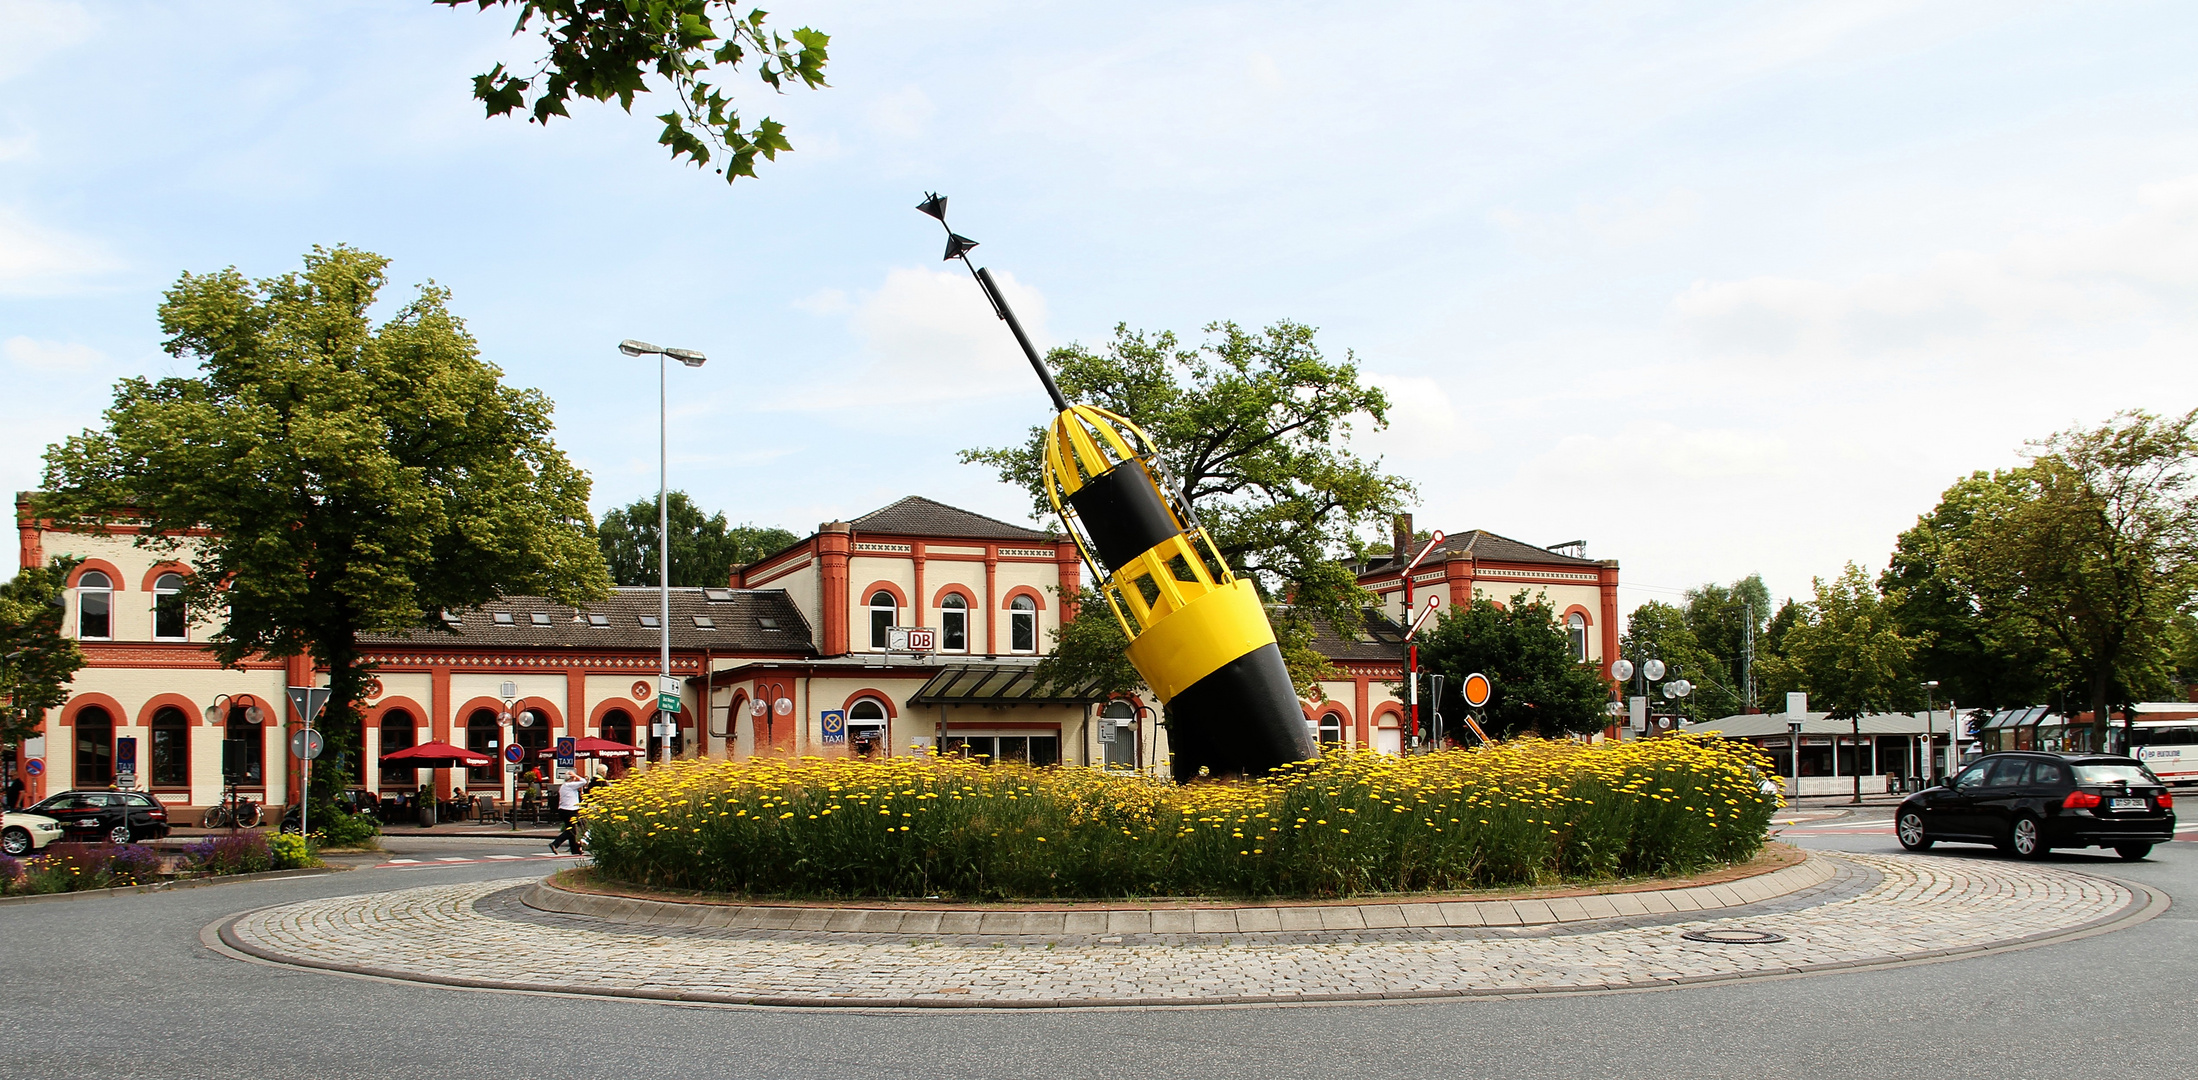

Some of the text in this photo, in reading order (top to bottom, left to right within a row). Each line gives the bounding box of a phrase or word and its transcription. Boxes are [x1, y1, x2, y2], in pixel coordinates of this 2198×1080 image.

[912, 634, 931, 646] DB
[824, 735, 844, 743] TAXI
[119, 763, 135, 771] TAXI
